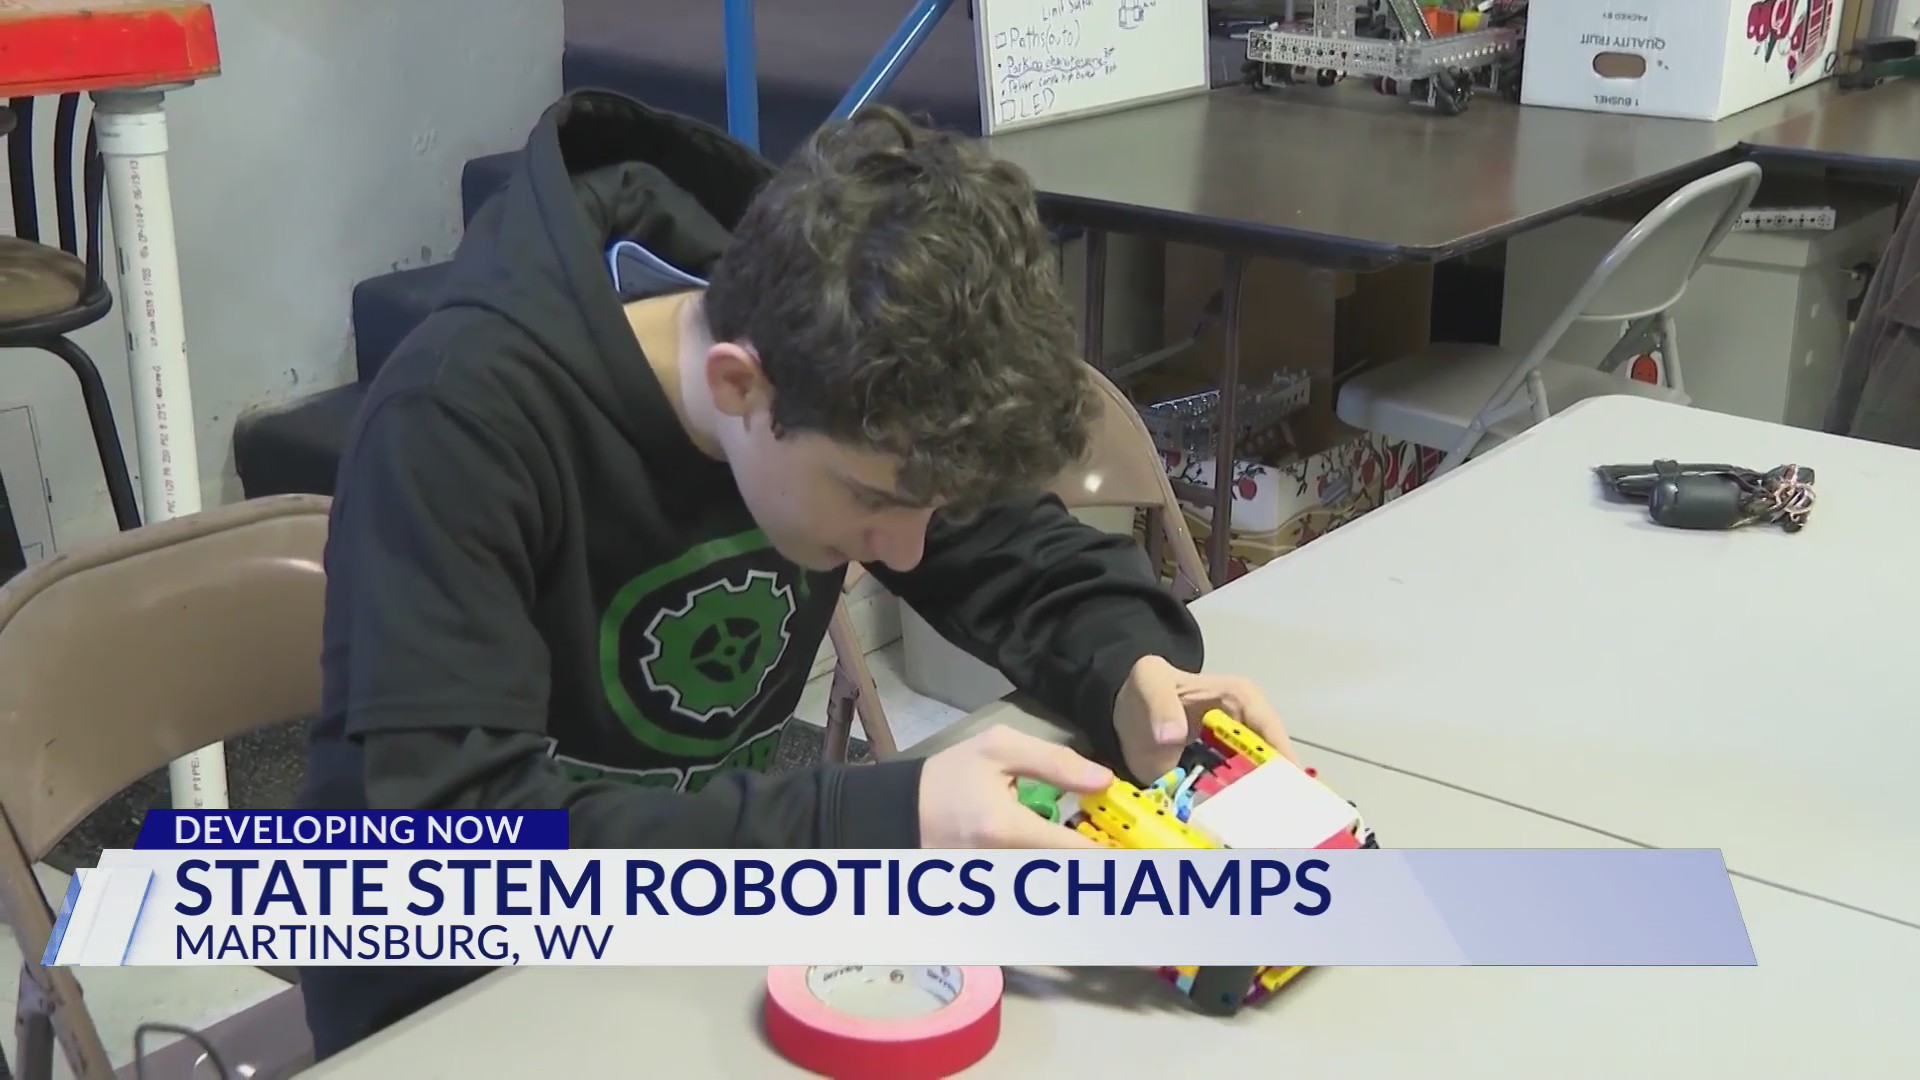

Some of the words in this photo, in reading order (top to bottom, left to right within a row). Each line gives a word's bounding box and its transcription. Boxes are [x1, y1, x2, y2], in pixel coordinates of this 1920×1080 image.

[1615, 13, 1648, 21] PACKED
[1580, 33, 1610, 45] FRUIT
[1613, 36, 1666, 50] QUALITY
[1020, 87, 1056, 118] LED
[1594, 95, 1632, 106] BUSHEL
[1635, 98, 1639, 107] 1
[190, 760, 202, 792] PIPE
